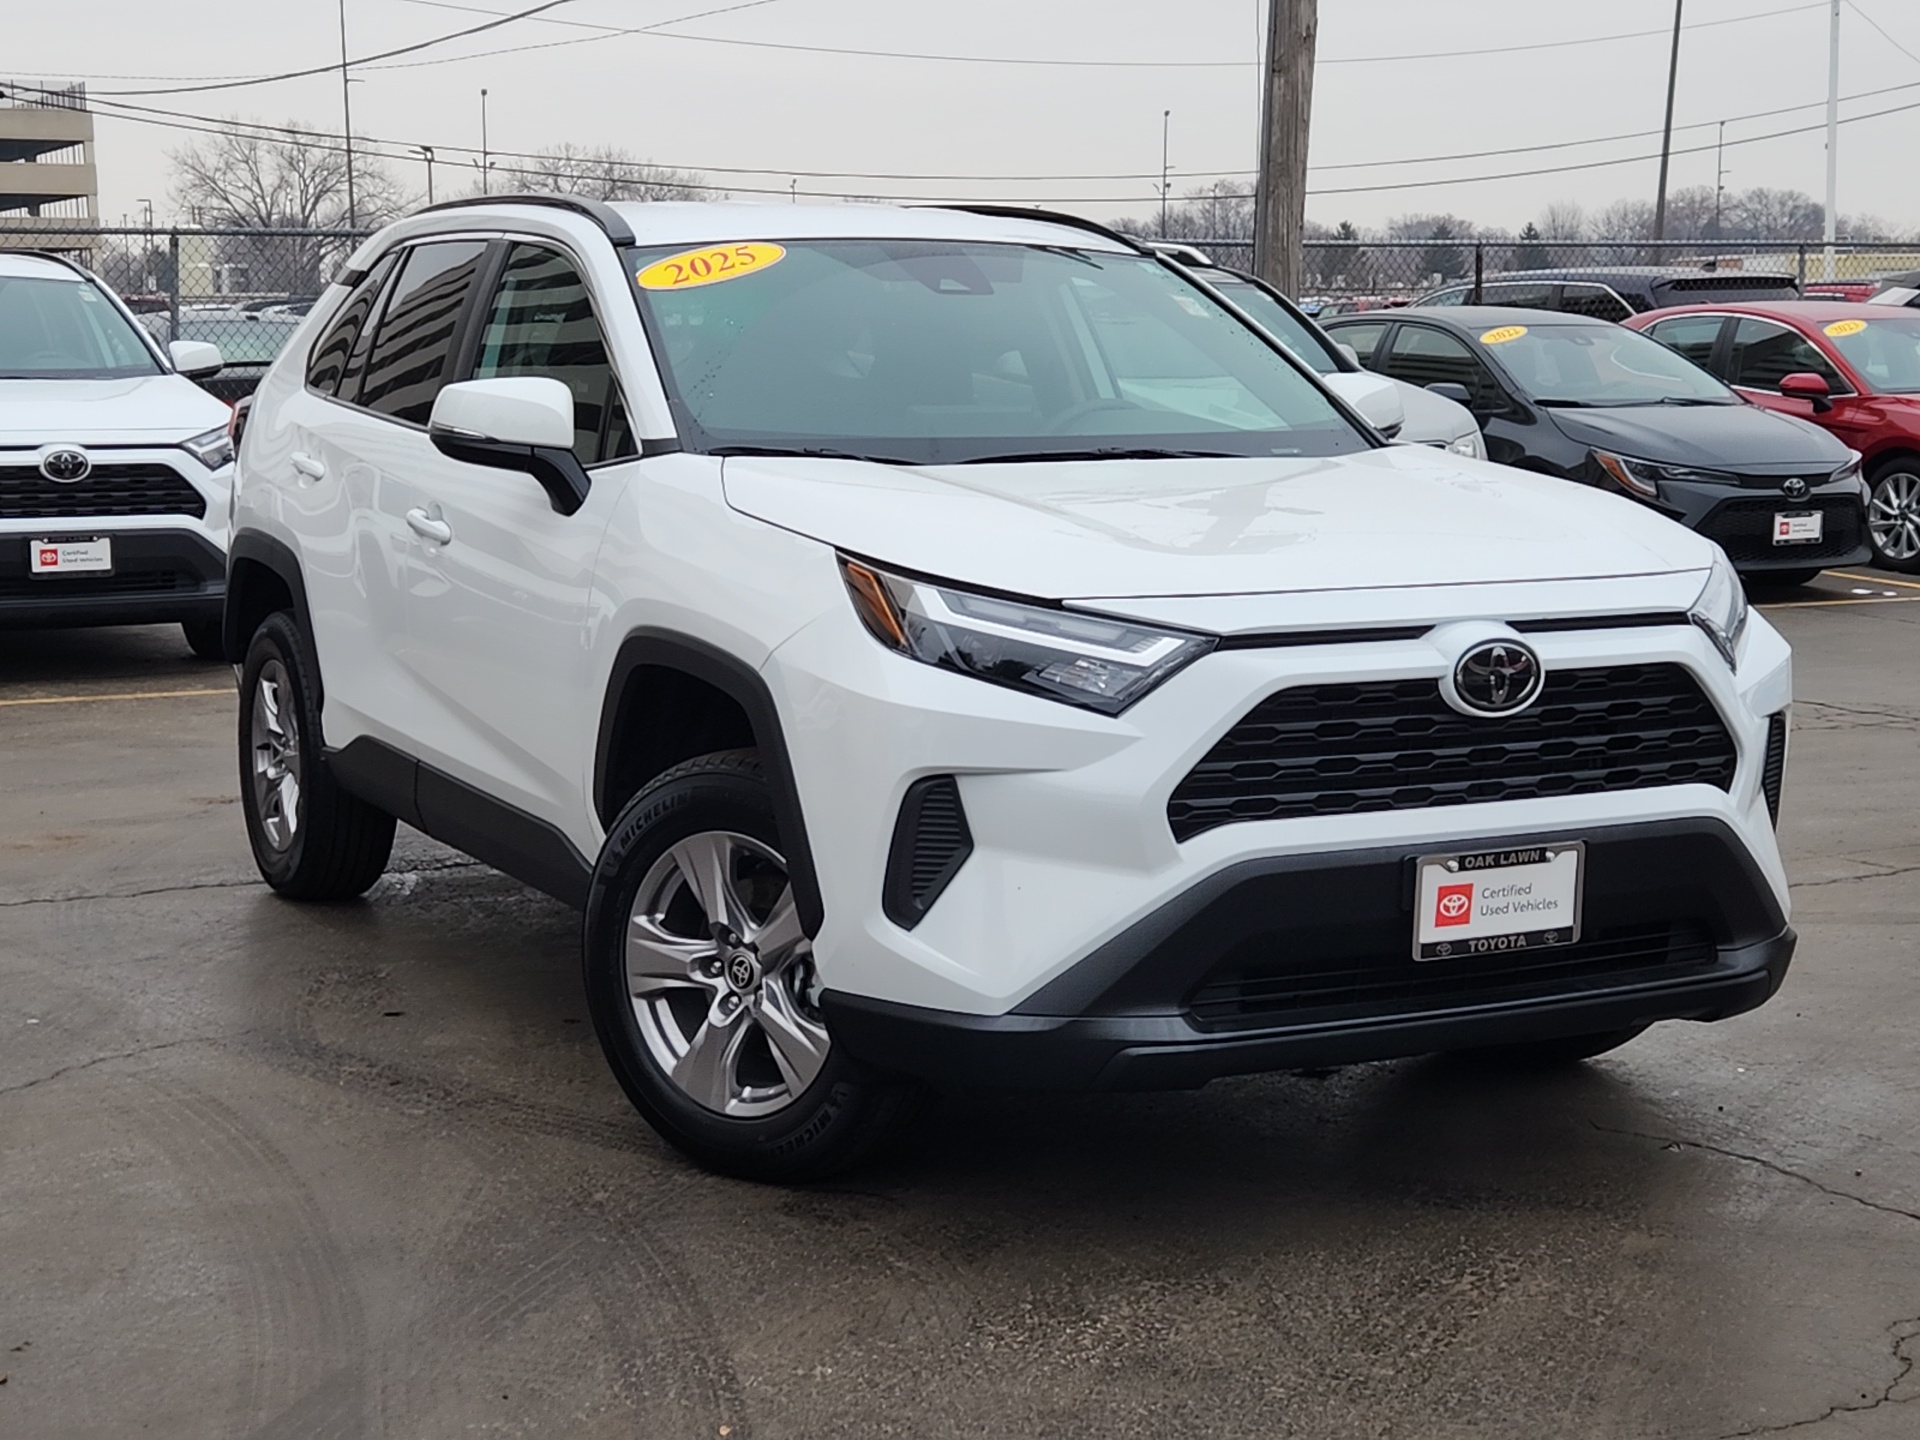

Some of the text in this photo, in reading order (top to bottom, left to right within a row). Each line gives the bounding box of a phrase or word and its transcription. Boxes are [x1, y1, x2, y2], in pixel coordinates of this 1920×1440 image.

[664, 246, 756, 285] 2025
[619, 790, 690, 850] MICHELIN
[1465, 850, 1540, 869] OAK LAWN
[1482, 883, 1533, 899] Certified
[1480, 898, 1558, 917] Used Vehicles
[1468, 935, 1527, 953] TOYOTA
[766, 1110, 832, 1155] MICHELI
